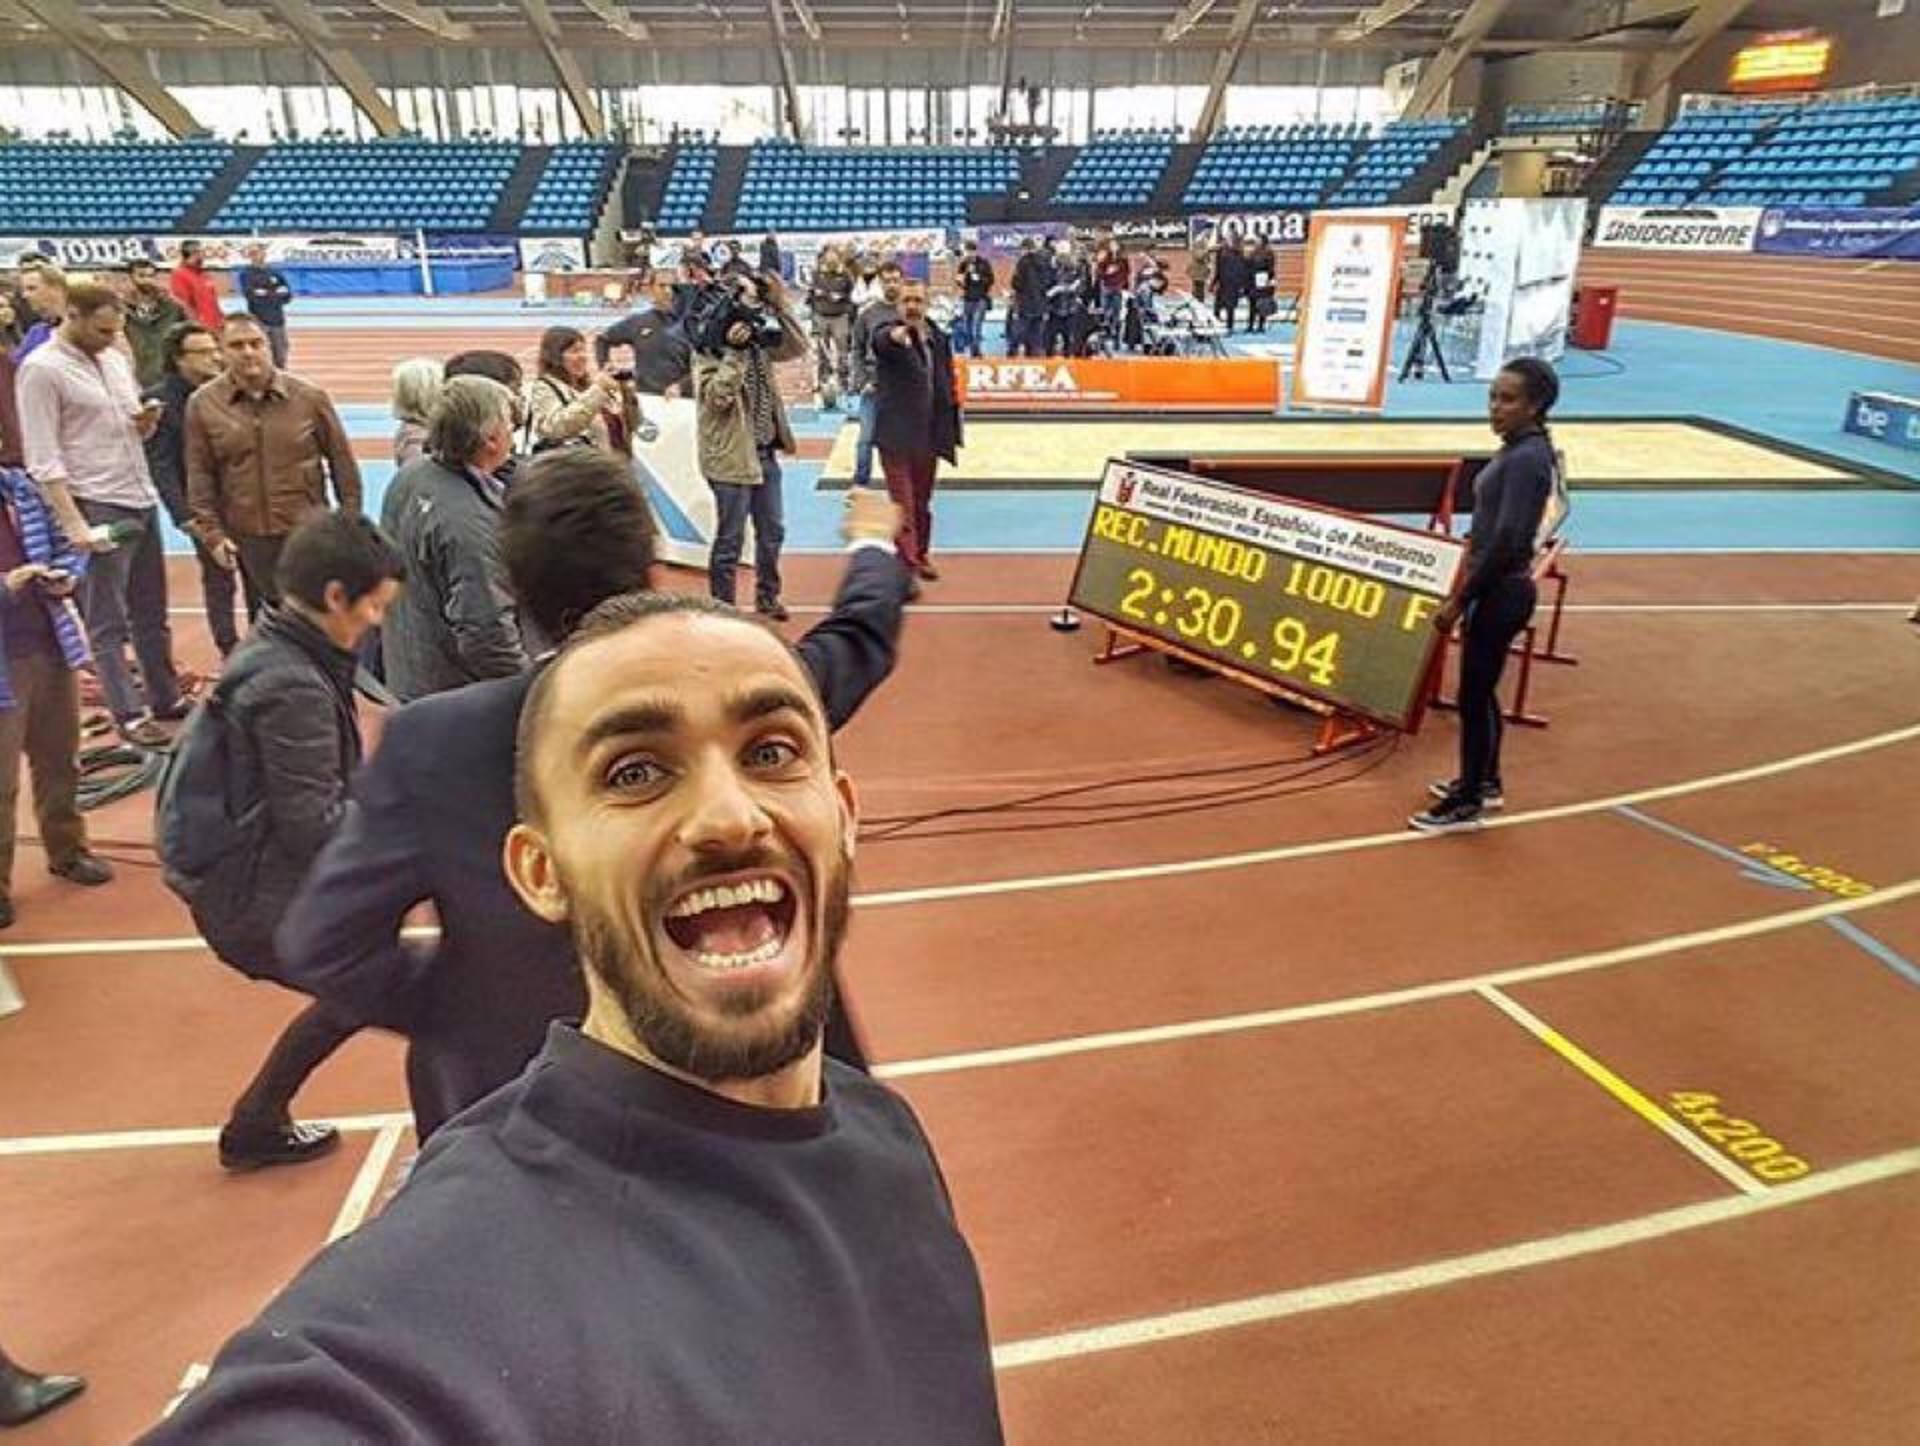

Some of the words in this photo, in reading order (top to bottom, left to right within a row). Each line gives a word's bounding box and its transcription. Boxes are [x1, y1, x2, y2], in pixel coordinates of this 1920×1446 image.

[1603, 220, 1751, 245] BRIDGESTONE
[966, 363, 1077, 390] RFEA
[1140, 479, 1171, 500] Real
[1172, 486, 1248, 518] Federación
[1252, 507, 1322, 540] Española
[1325, 528, 1349, 545] de
[1350, 531, 1437, 567] Atletismo
[1094, 505, 1267, 583] REC.MUNDO
[1285, 560, 1386, 619] 1000
[1403, 593, 1441, 631] F
[1121, 568, 1341, 686] 2:30.94
[1668, 1090, 1809, 1180] 4x200
